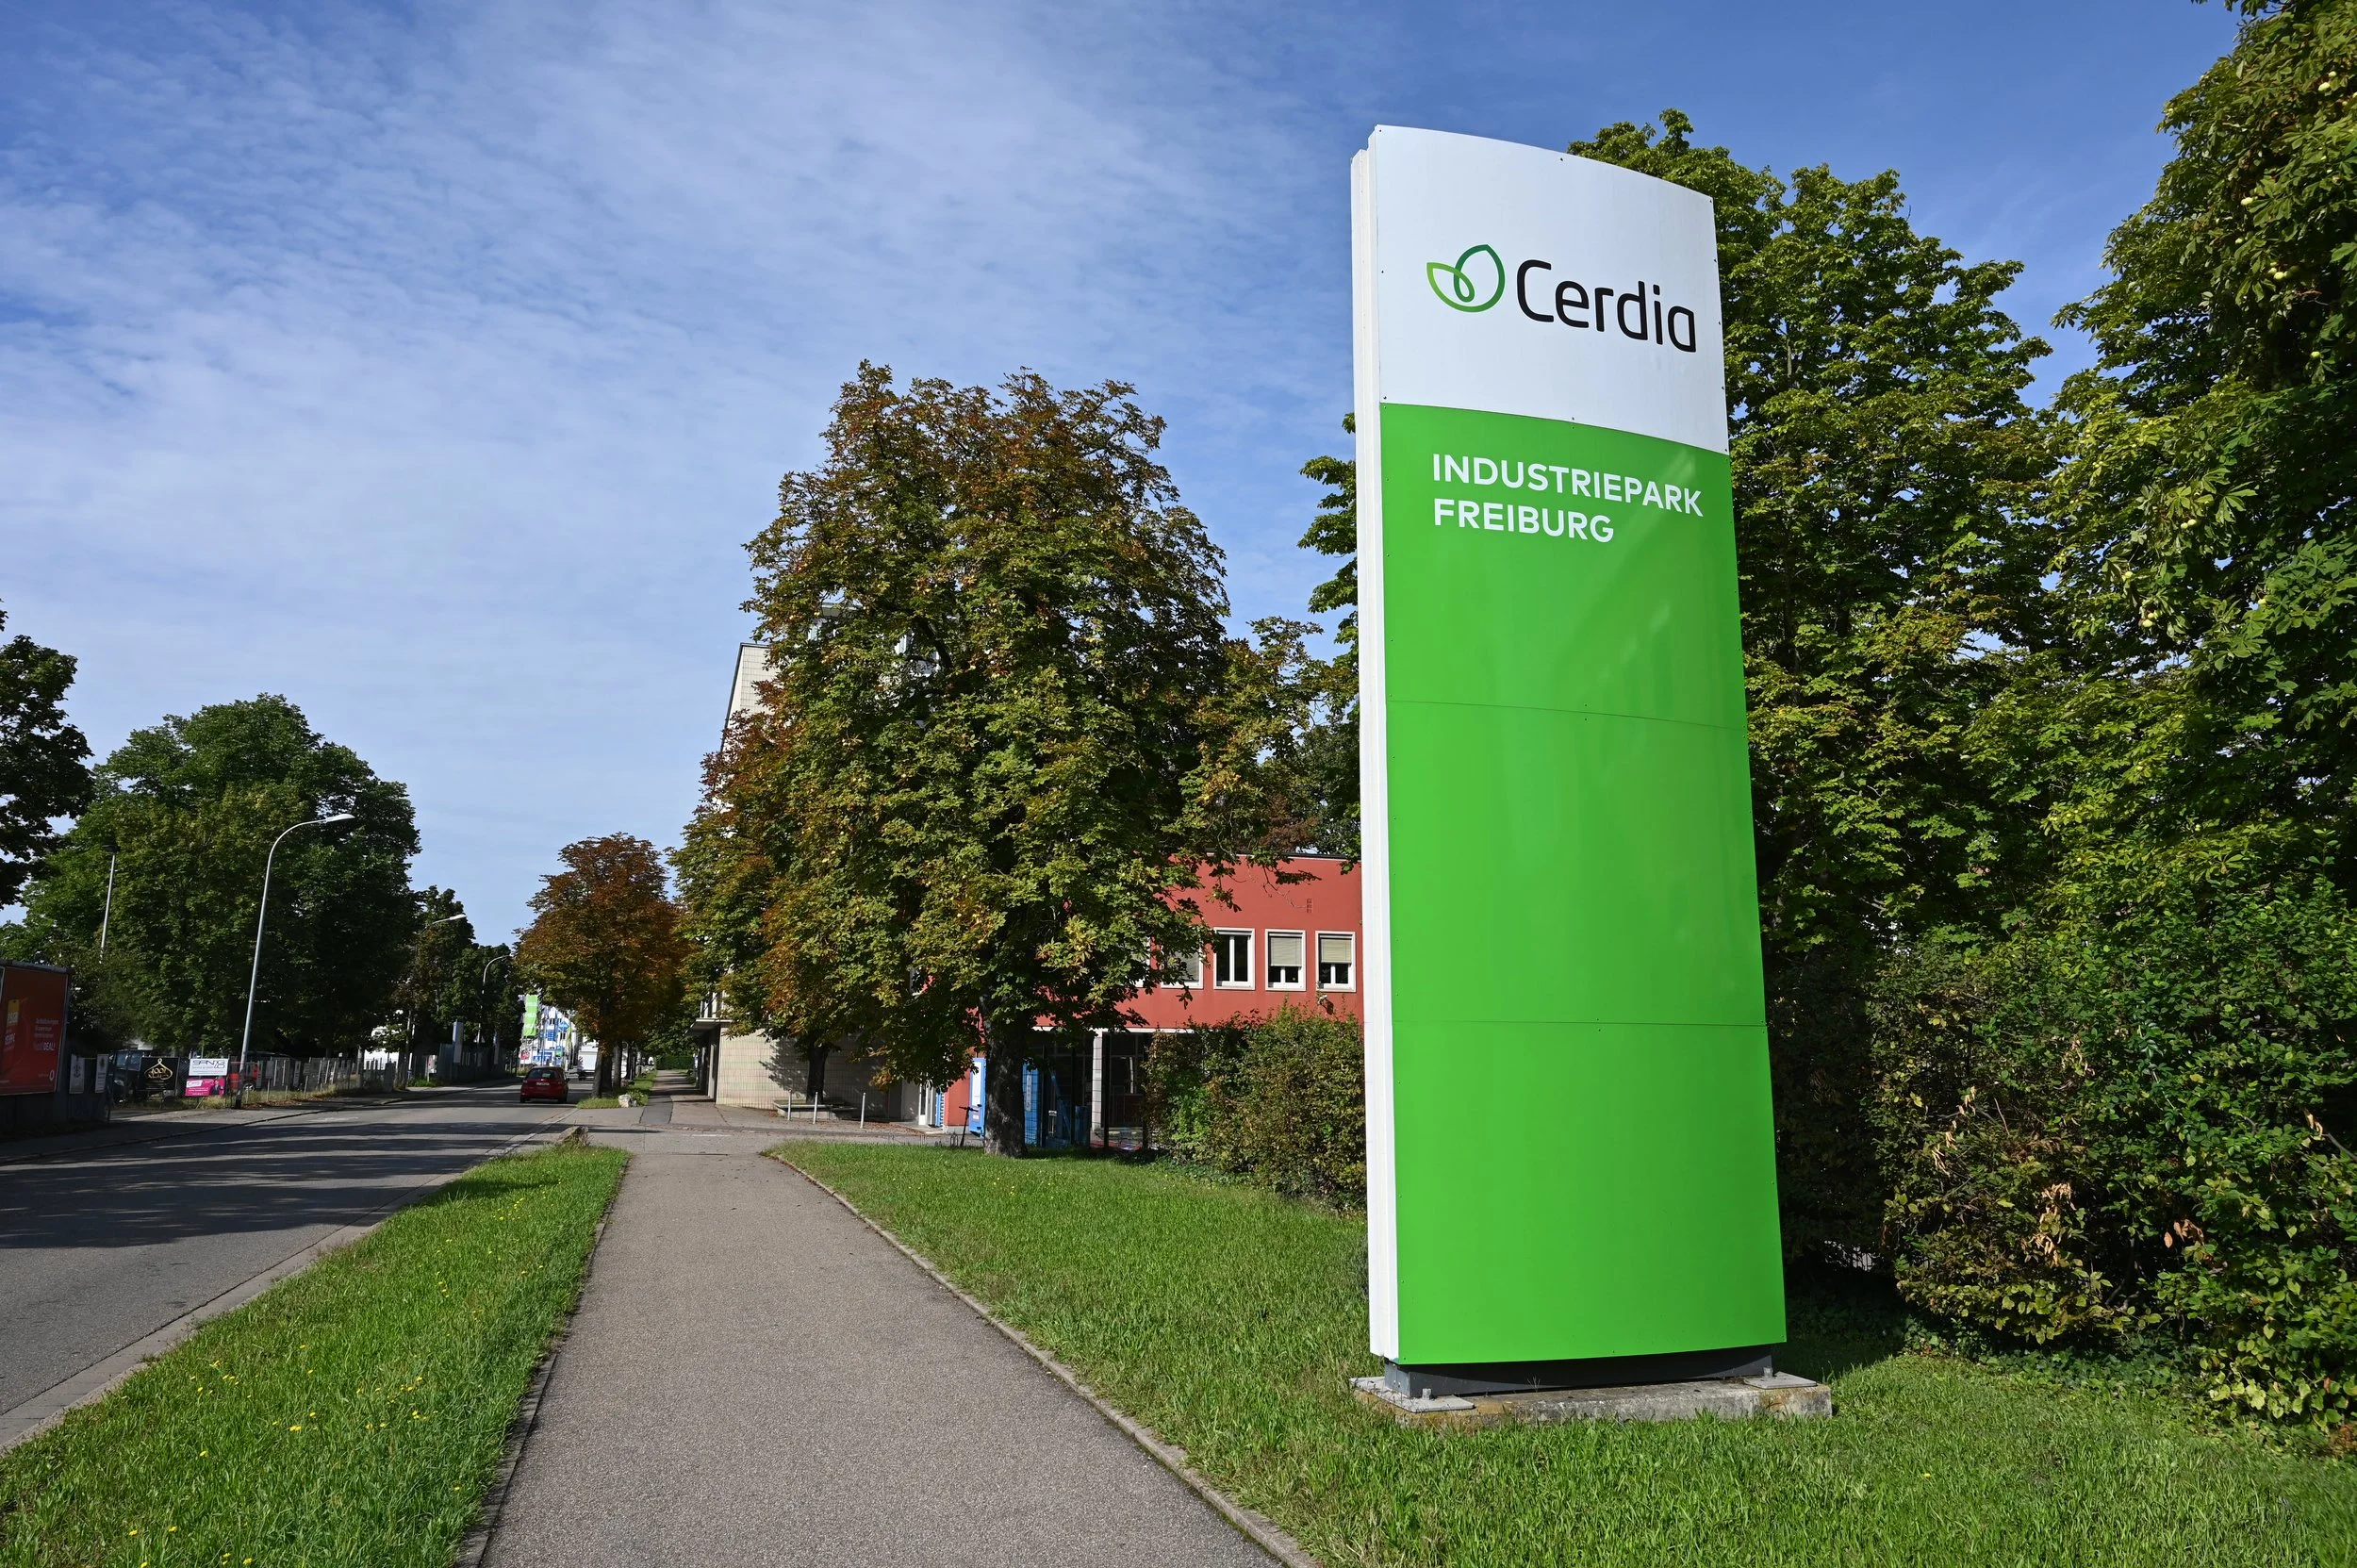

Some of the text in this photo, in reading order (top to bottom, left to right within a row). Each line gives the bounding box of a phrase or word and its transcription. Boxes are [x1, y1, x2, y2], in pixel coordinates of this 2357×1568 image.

[1517, 258, 1696, 353] Cerdia
[1432, 454, 1704, 518] INDUSTRIEPARK
[1433, 498, 1614, 543] FREIBURG
